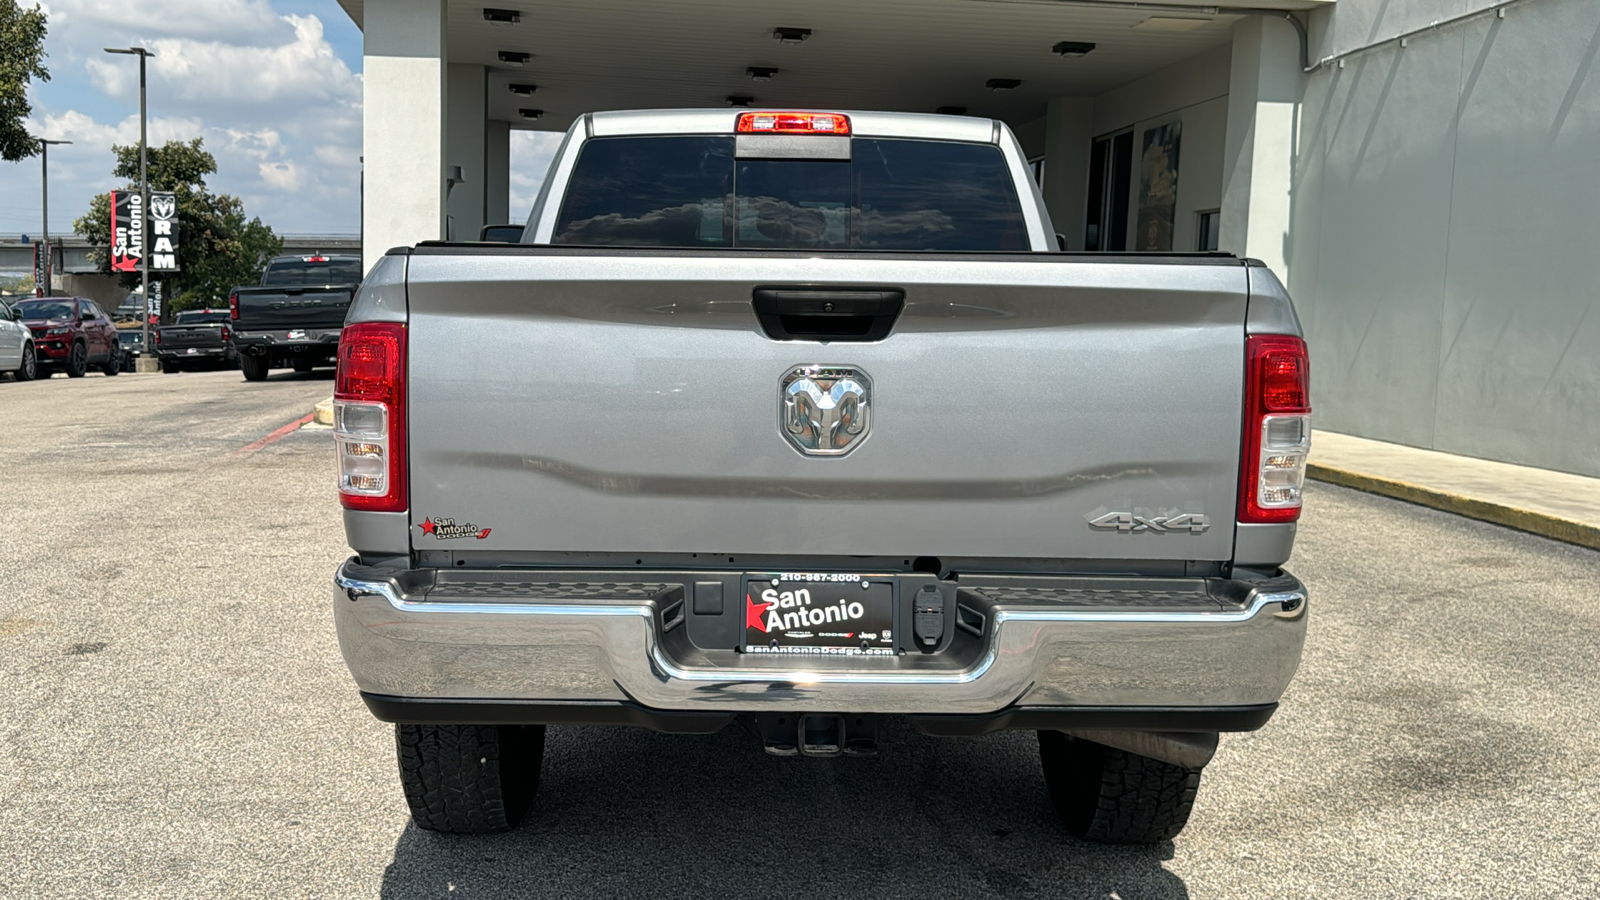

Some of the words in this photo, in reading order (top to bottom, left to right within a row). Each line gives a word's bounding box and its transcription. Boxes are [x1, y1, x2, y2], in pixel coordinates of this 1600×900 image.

[127, 195, 142, 258] Antonio
[113, 227, 127, 257] San
[153, 220, 175, 268] RAM
[434, 517, 455, 526] San
[436, 523, 478, 535] Antonio
[761, 588, 811, 611] San
[766, 598, 864, 633] Antonio
[858, 631, 877, 640] Jeep
